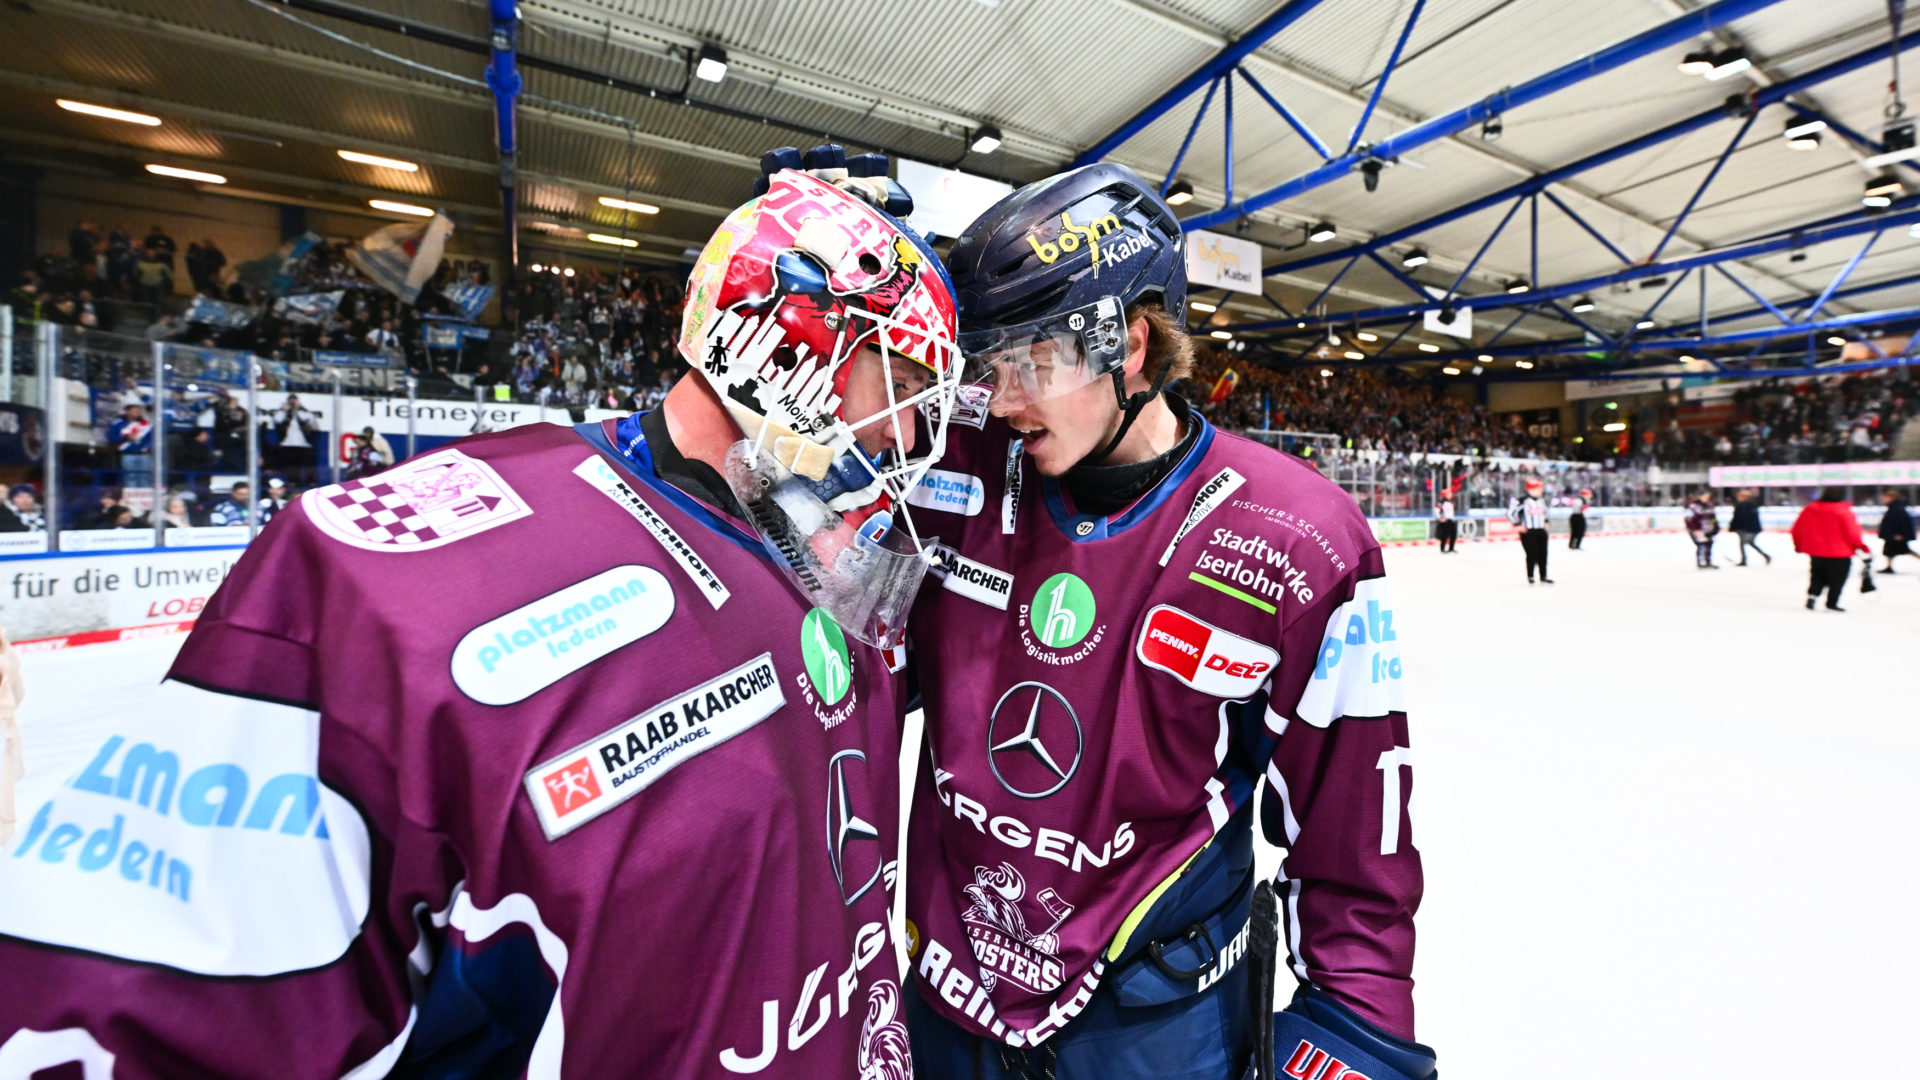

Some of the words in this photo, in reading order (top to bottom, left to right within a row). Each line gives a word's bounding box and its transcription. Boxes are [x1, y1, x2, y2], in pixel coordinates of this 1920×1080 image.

[1102, 227, 1157, 268] Kabel
[361, 398, 521, 430] Tiemeyer
[777, 394, 810, 426] Moin
[616, 482, 723, 592] KIRCHHOFF
[1232, 500, 1286, 520] FISCHER
[1296, 519, 1346, 573] SCHÄFER
[1264, 516, 1308, 538] IMMOBILIEN
[12, 572, 59, 599] für
[74, 569, 120, 593] die
[1195, 550, 1285, 601] Iserlohn
[477, 579, 648, 674] platzmann
[1019, 604, 1029, 627] Die
[797, 672, 814, 705] Die
[599, 711, 679, 774] RAAB
[682, 664, 775, 728] KARCHER
[612, 727, 711, 788] BAUSTOFFHANDEL
